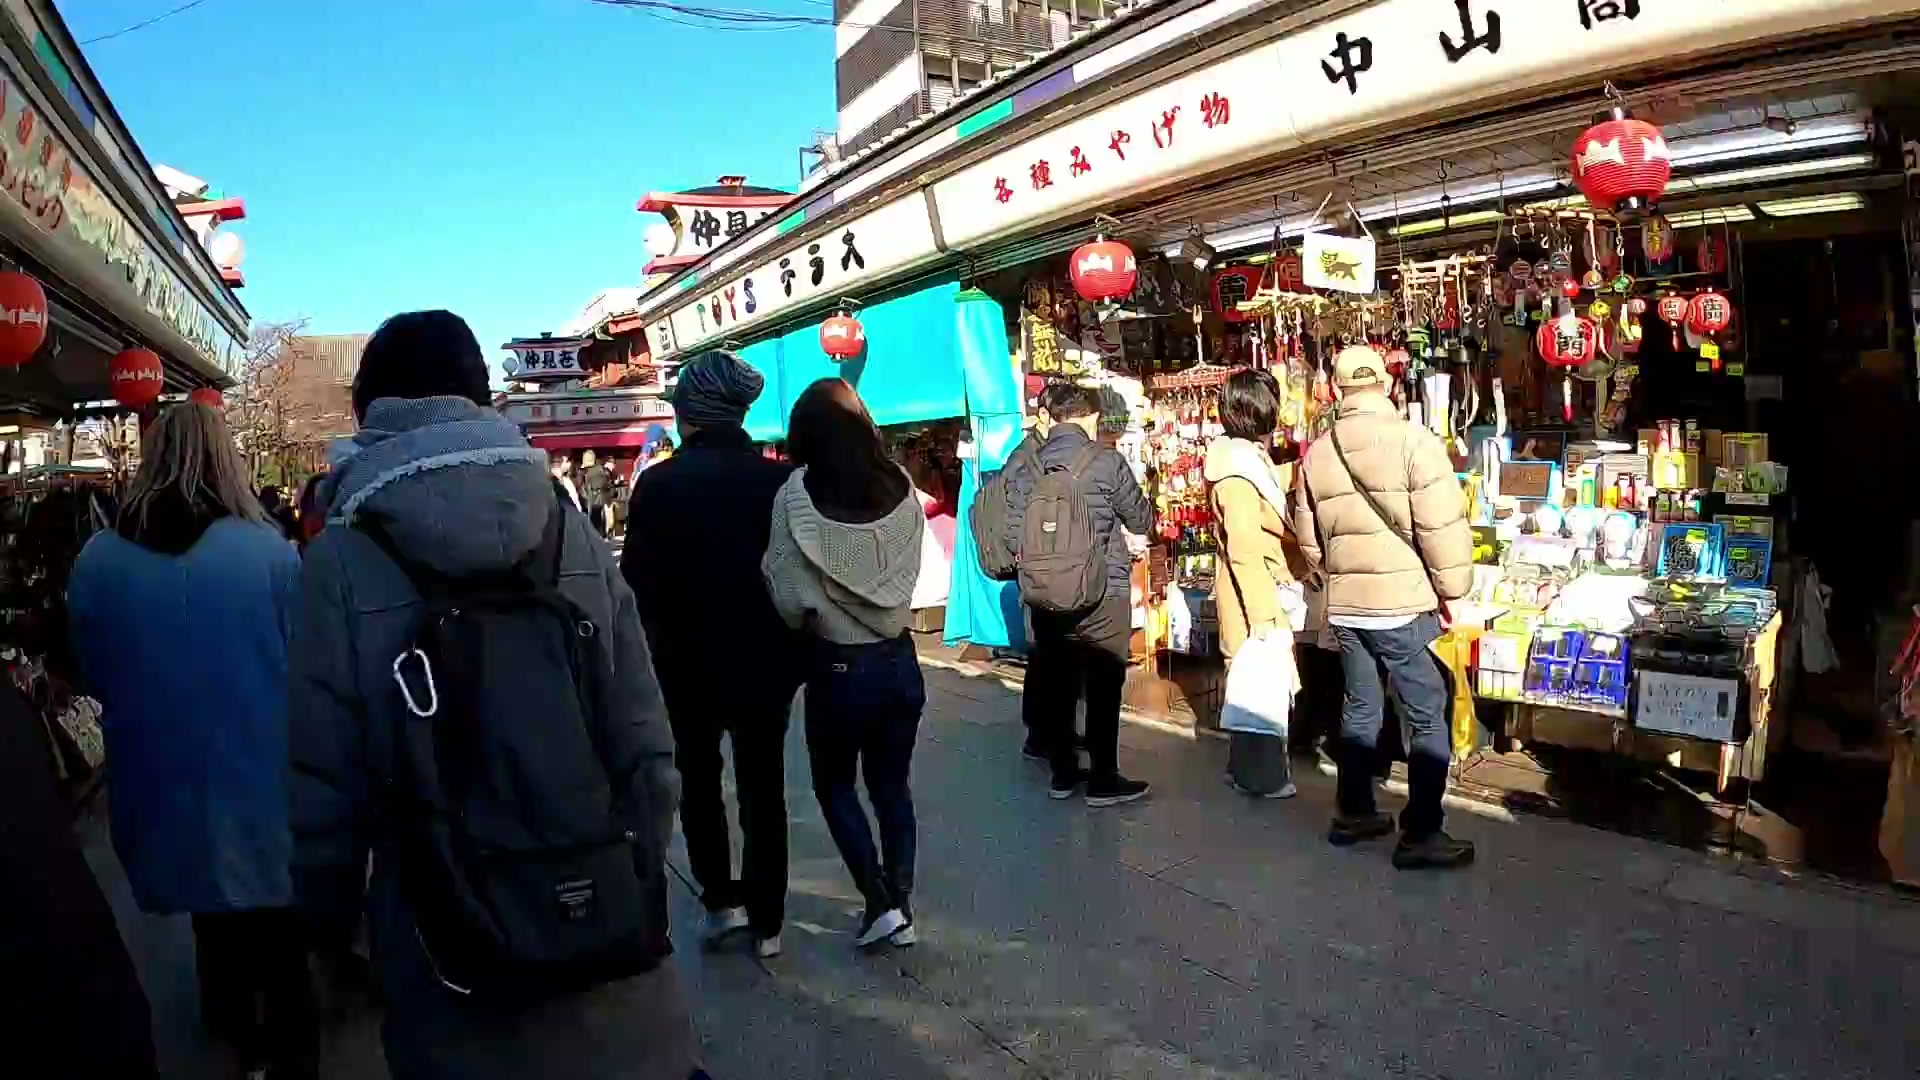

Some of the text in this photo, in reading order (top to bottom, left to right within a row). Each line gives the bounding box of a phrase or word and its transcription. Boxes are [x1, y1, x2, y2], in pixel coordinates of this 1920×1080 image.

[994, 91, 1230, 204] 各種みやげ物
[696, 277, 757, 333] TOYS
